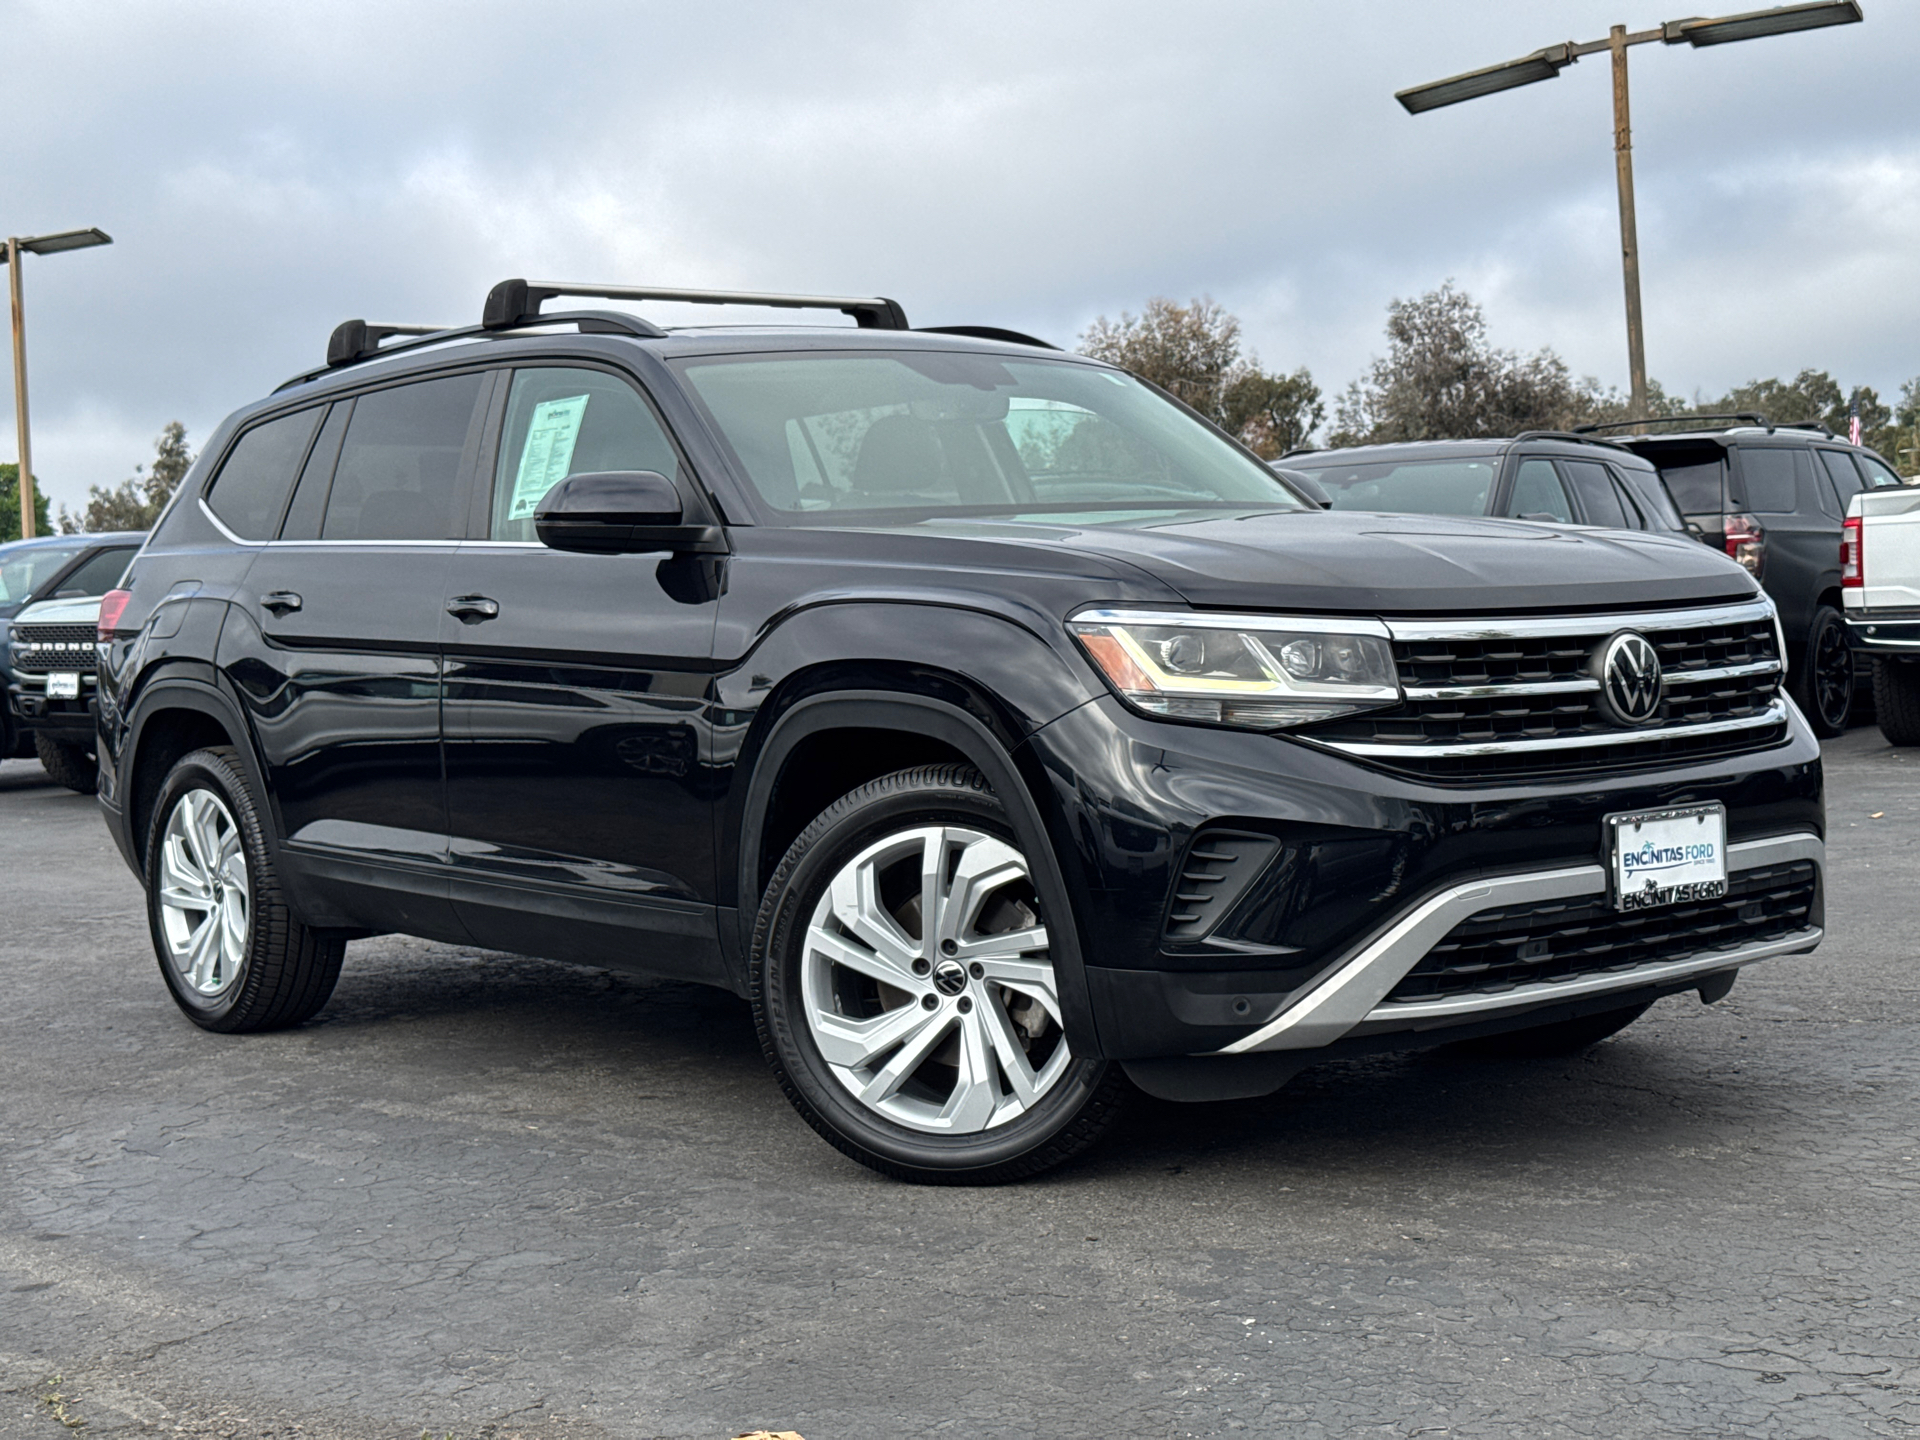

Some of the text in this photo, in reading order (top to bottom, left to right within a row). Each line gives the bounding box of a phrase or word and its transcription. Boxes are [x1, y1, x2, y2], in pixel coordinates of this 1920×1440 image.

[1623, 843, 1714, 868] ENCINITAS FORD
[1623, 881, 1724, 910] ENCINITAS FORD
[770, 966, 807, 1075] MICHELIN
